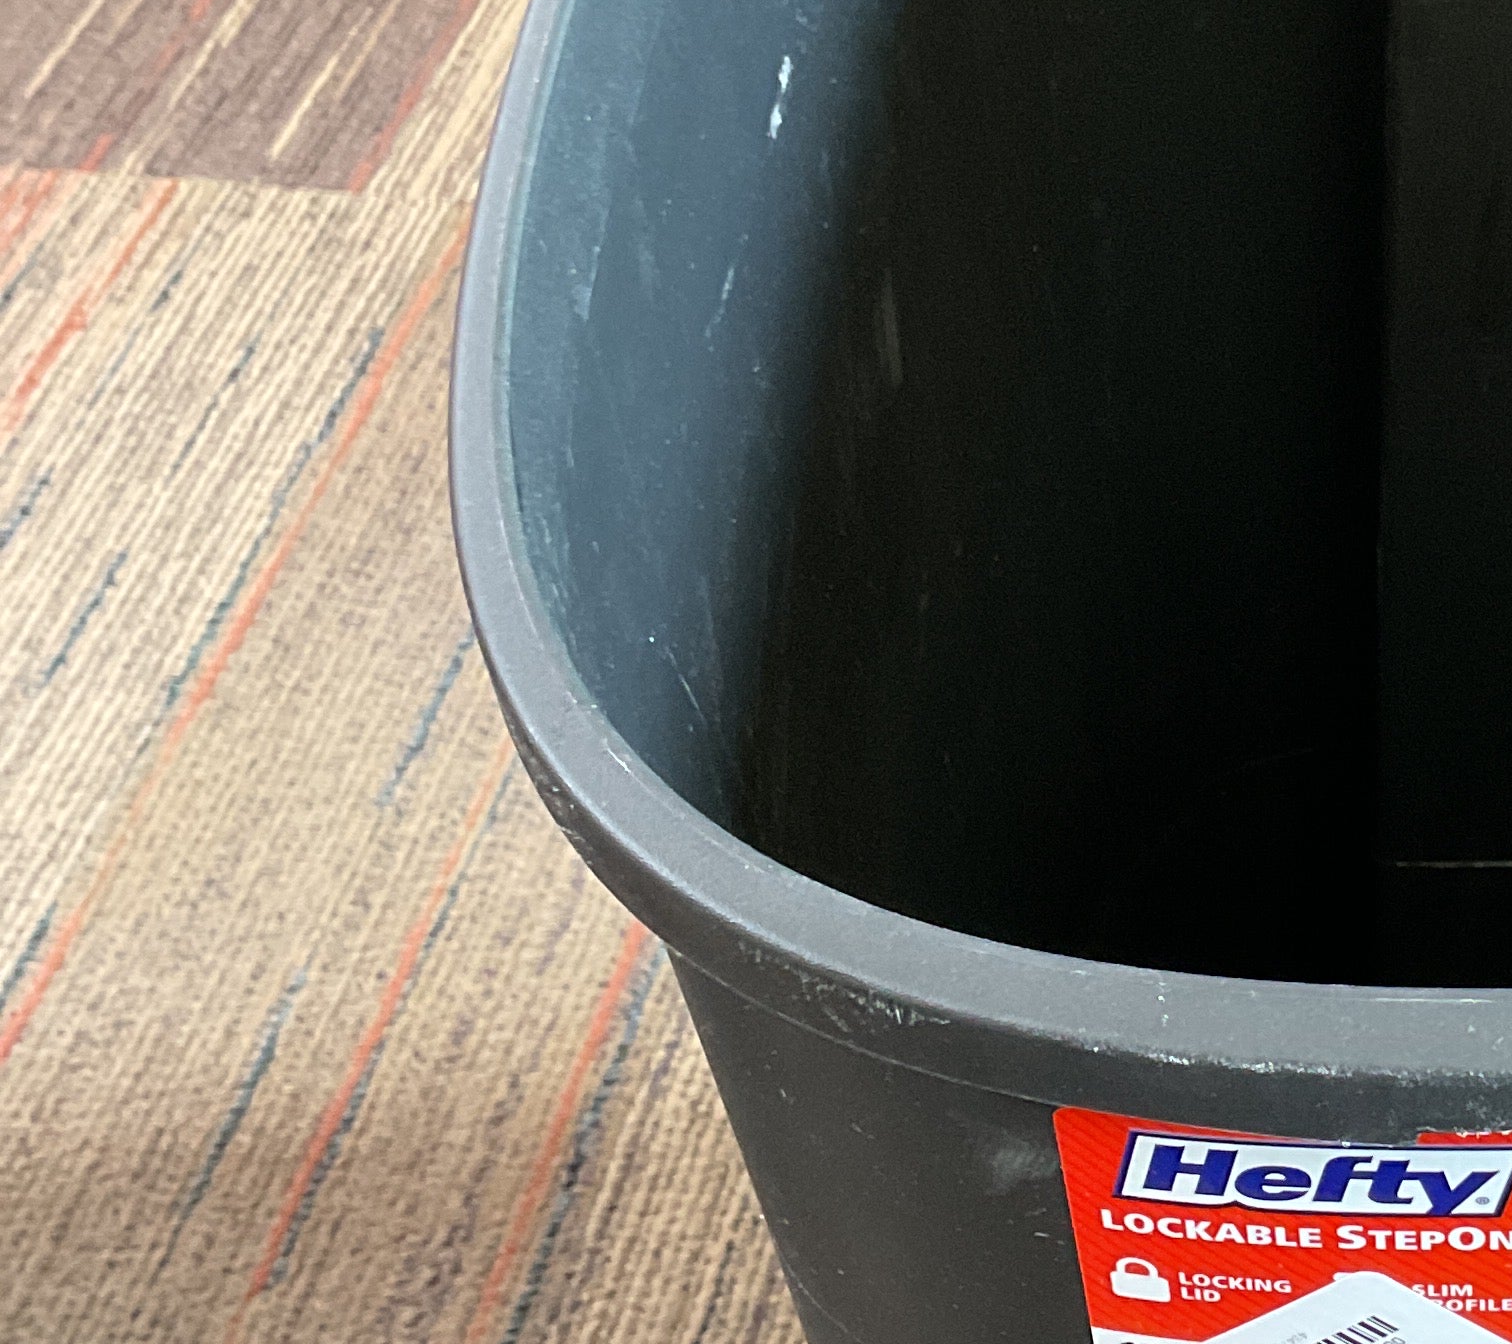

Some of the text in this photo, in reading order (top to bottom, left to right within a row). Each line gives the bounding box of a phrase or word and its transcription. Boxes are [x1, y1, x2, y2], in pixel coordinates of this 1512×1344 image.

[1101, 1208, 1322, 1248] LOCKABLE
[1178, 1271, 1292, 1293] LOCKING
[1411, 1283, 1473, 1297] SLIM
[1180, 1287, 1221, 1302] LID
